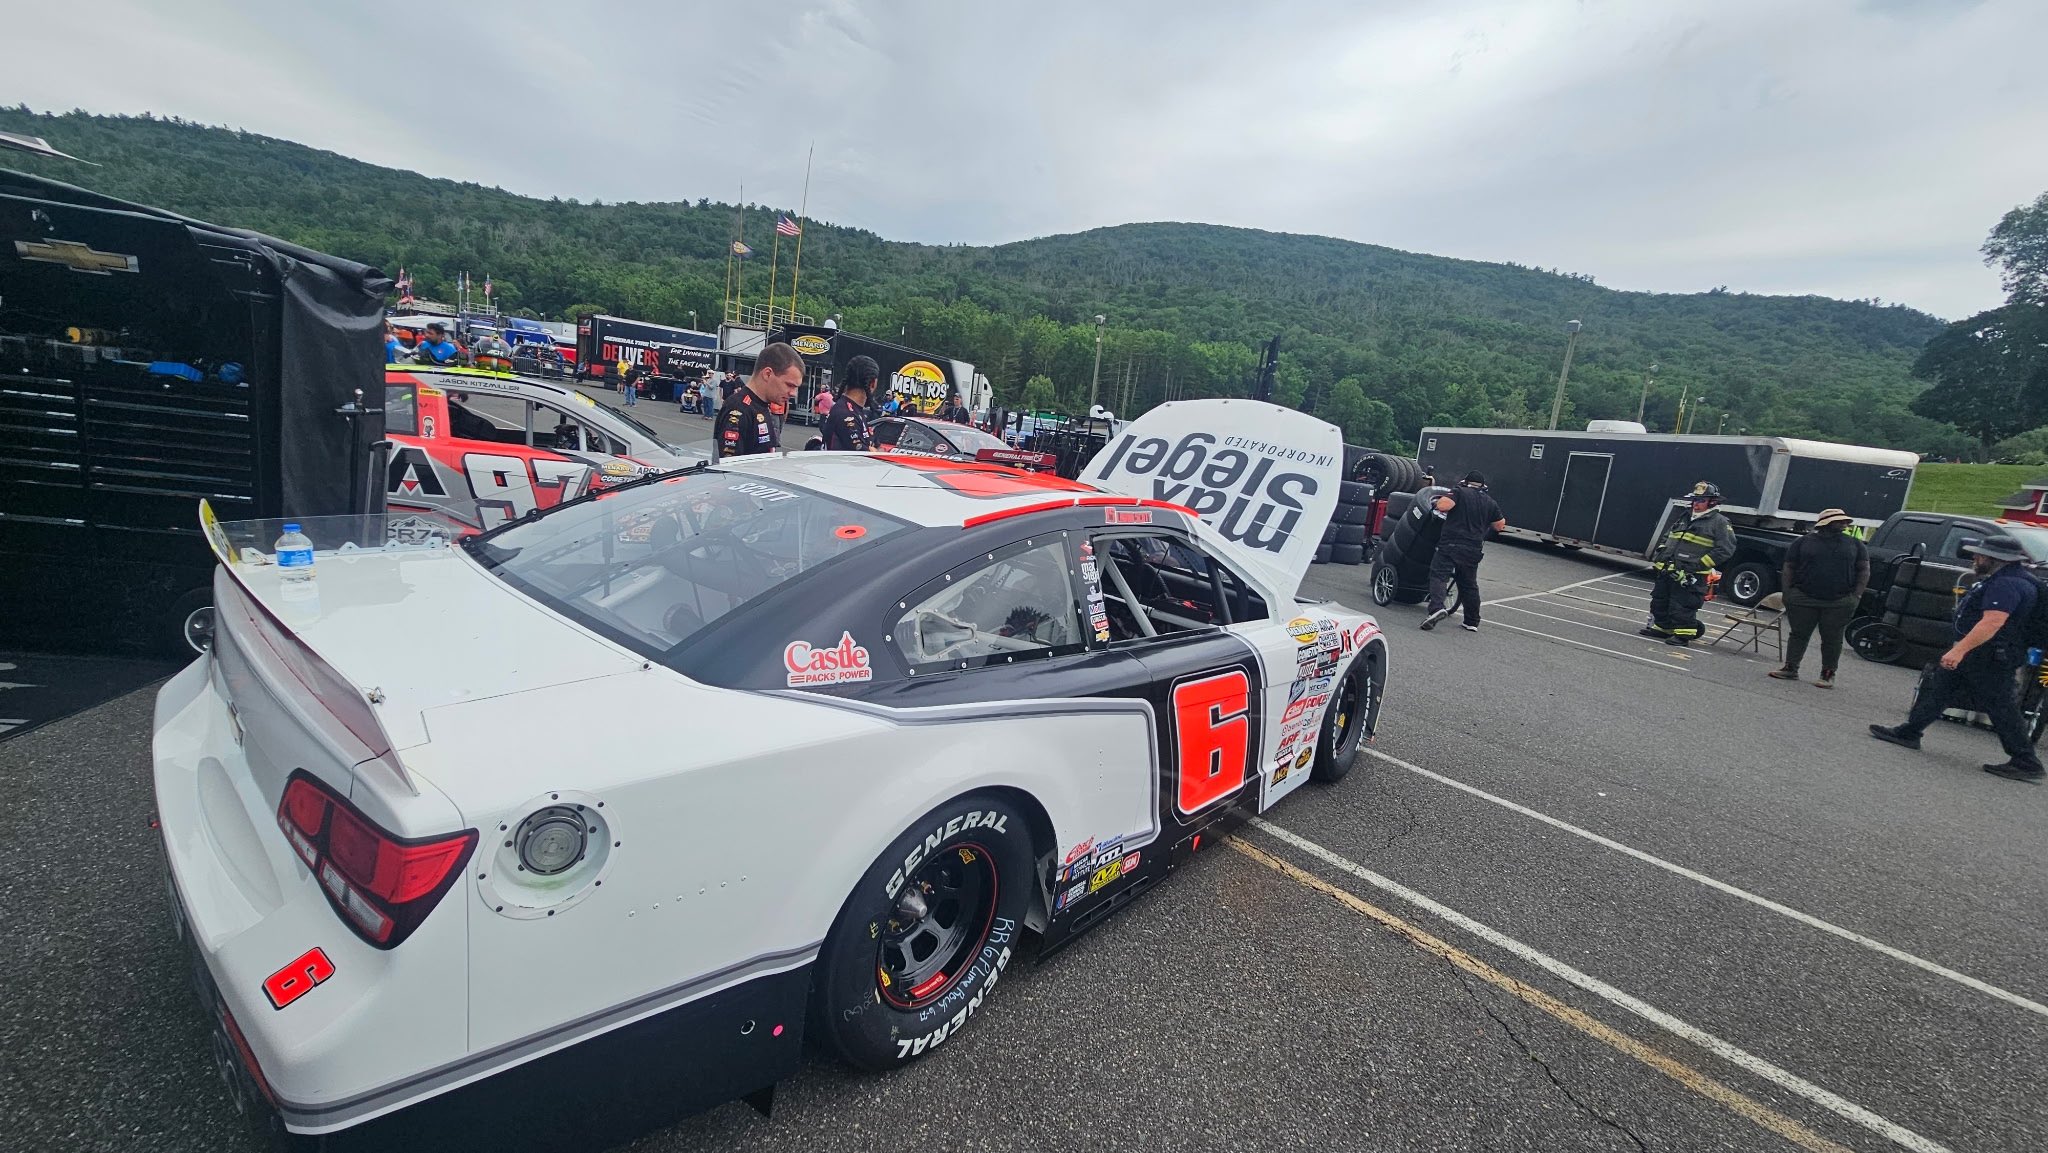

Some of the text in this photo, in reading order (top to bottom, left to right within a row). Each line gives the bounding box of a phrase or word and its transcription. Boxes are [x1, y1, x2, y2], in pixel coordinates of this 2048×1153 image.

[604, 336, 635, 345] GENERAL
[791, 339, 830, 350] MENARDS
[603, 344, 660, 367] DELIVERS
[438, 378, 520, 391] JASON KITZMILLER
[993, 452, 1021, 460] GENERAL
[1224, 435, 1335, 467] INCORPORATED
[1097, 432, 1319, 511] Siegel
[728, 482, 800, 501] SCOTT
[1286, 622, 1320, 638] MENARDS
[787, 634, 868, 673] Castle
[805, 669, 870, 683] PACKS POWER
[1174, 671, 1249, 814] 6
[885, 810, 1008, 900] GENERAL
[262, 946, 336, 1010] 6
[896, 946, 1012, 1059] GENERAL
